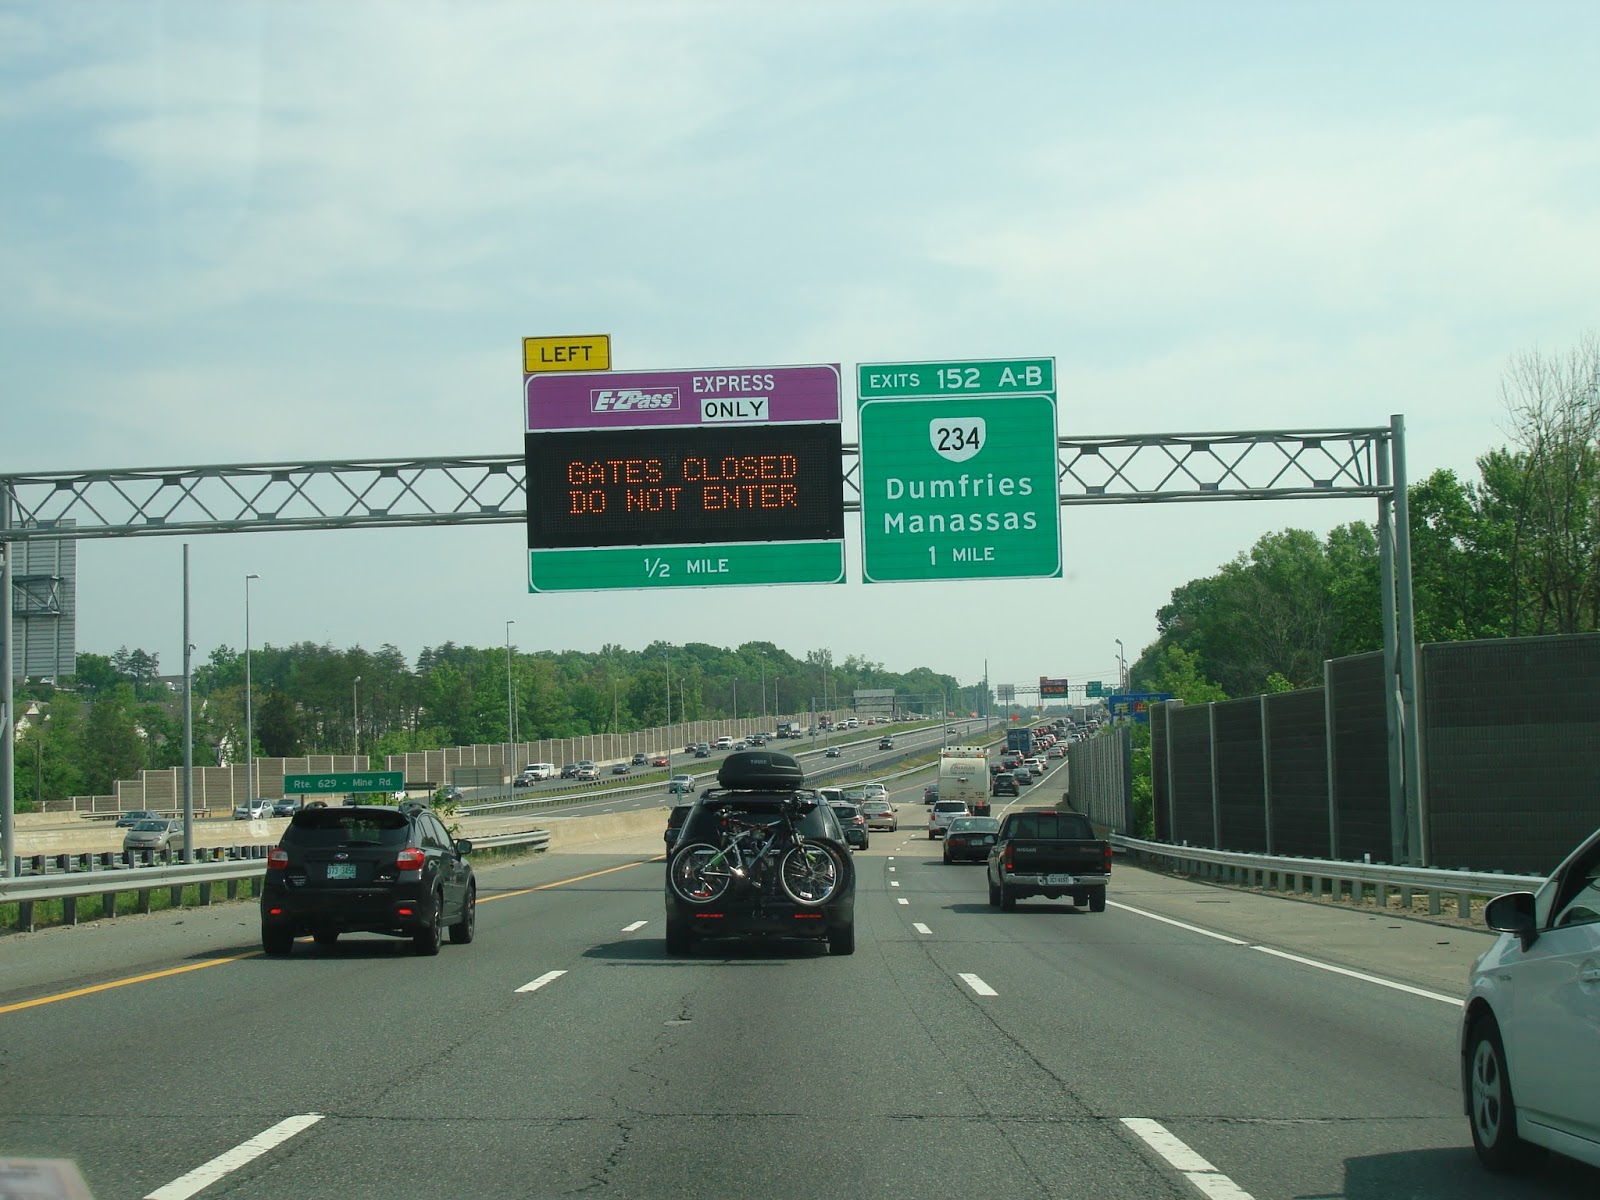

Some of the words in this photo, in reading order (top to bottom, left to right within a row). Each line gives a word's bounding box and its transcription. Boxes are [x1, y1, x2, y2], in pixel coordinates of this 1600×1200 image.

[541, 345, 593, 363] LEFT
[692, 374, 775, 393] EXPRESS
[869, 373, 921, 389] EXITS
[936, 367, 981, 389] 152
[998, 366, 1043, 388] A-B
[594, 390, 674, 411] E-ZPass
[704, 400, 765, 418] ONLY
[937, 426, 980, 451] 234
[567, 458, 663, 485] GATES
[682, 454, 798, 482] CLOSED
[886, 473, 1034, 500] Dumfries
[568, 489, 607, 515] DO
[626, 486, 682, 512] NOT
[702, 483, 799, 511] ENTER
[884, 510, 1038, 534] Manassas
[928, 545, 936, 566] 1
[952, 547, 995, 562] MILE
[643, 557, 671, 578] 1/2
[686, 558, 730, 574] MILE
[293, 780, 312, 789] Rte.
[317, 779, 337, 788] 629
[352, 778, 373, 787] Mine
[378, 777, 394, 786] Rd.
